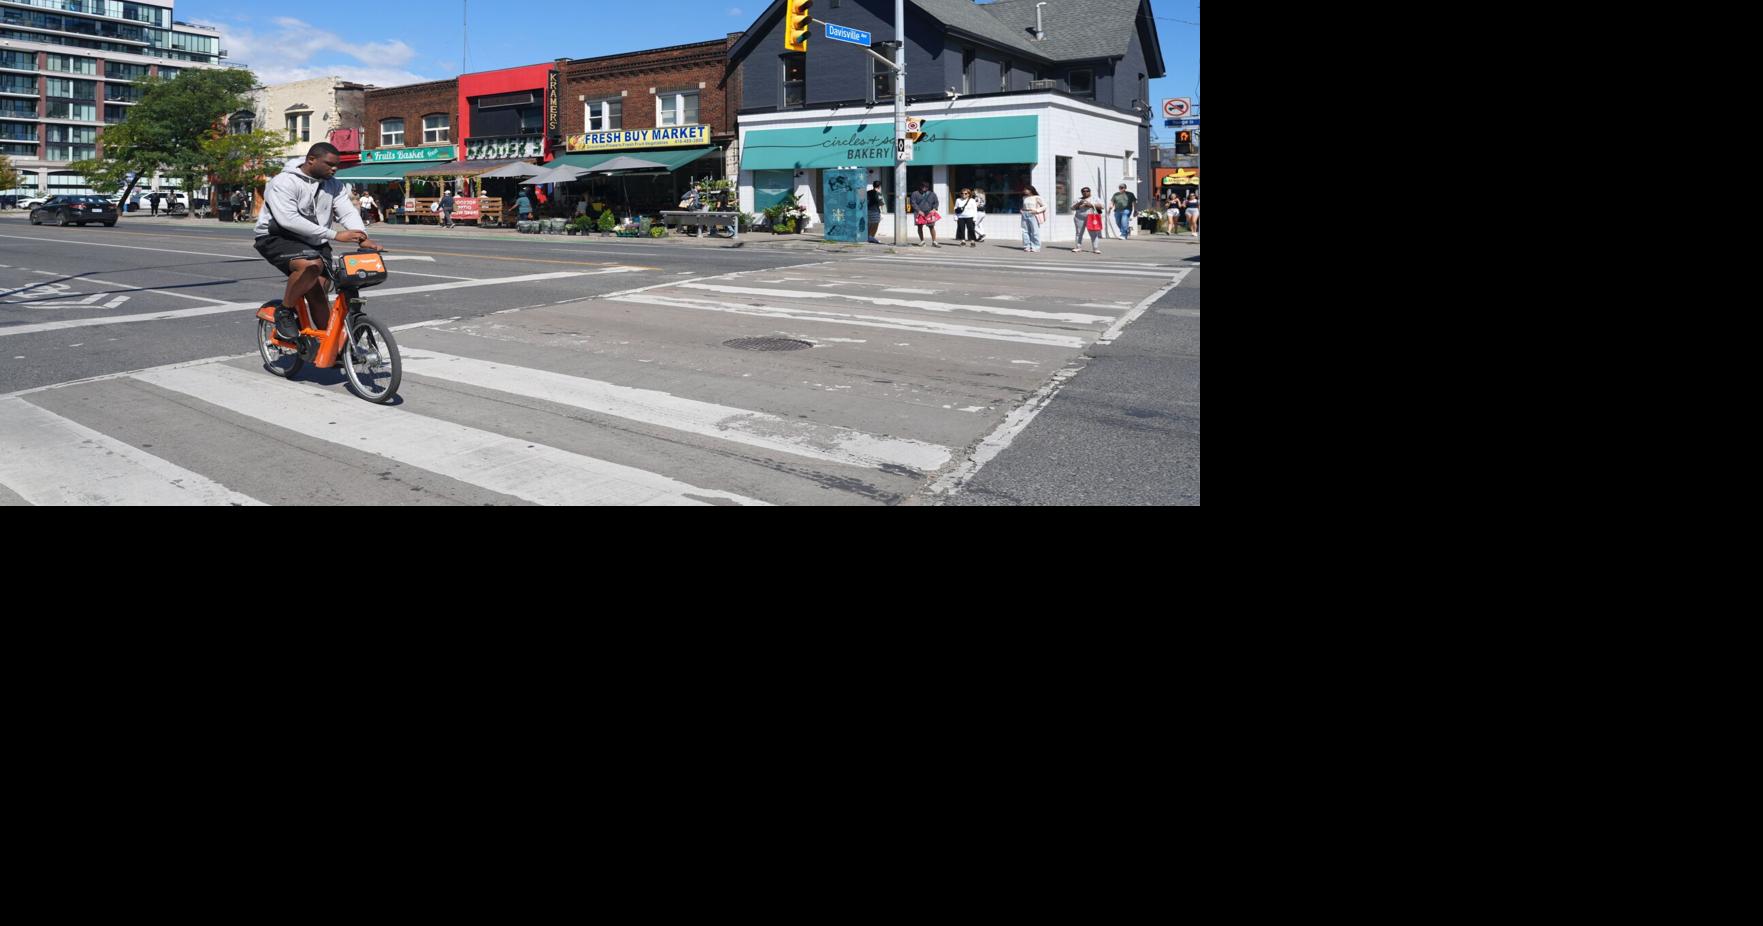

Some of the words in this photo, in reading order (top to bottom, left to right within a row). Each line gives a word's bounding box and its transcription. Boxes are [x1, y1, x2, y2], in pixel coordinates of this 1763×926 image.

[829, 25, 859, 40] Davisville
[585, 132, 621, 144] FRESH
[624, 130, 648, 142] BUY
[652, 126, 705, 140] MARKET
[822, 132, 865, 148] circles
[374, 150, 395, 160] Fruits
[397, 150, 425, 160] Basket
[847, 147, 889, 159] BAKERY
